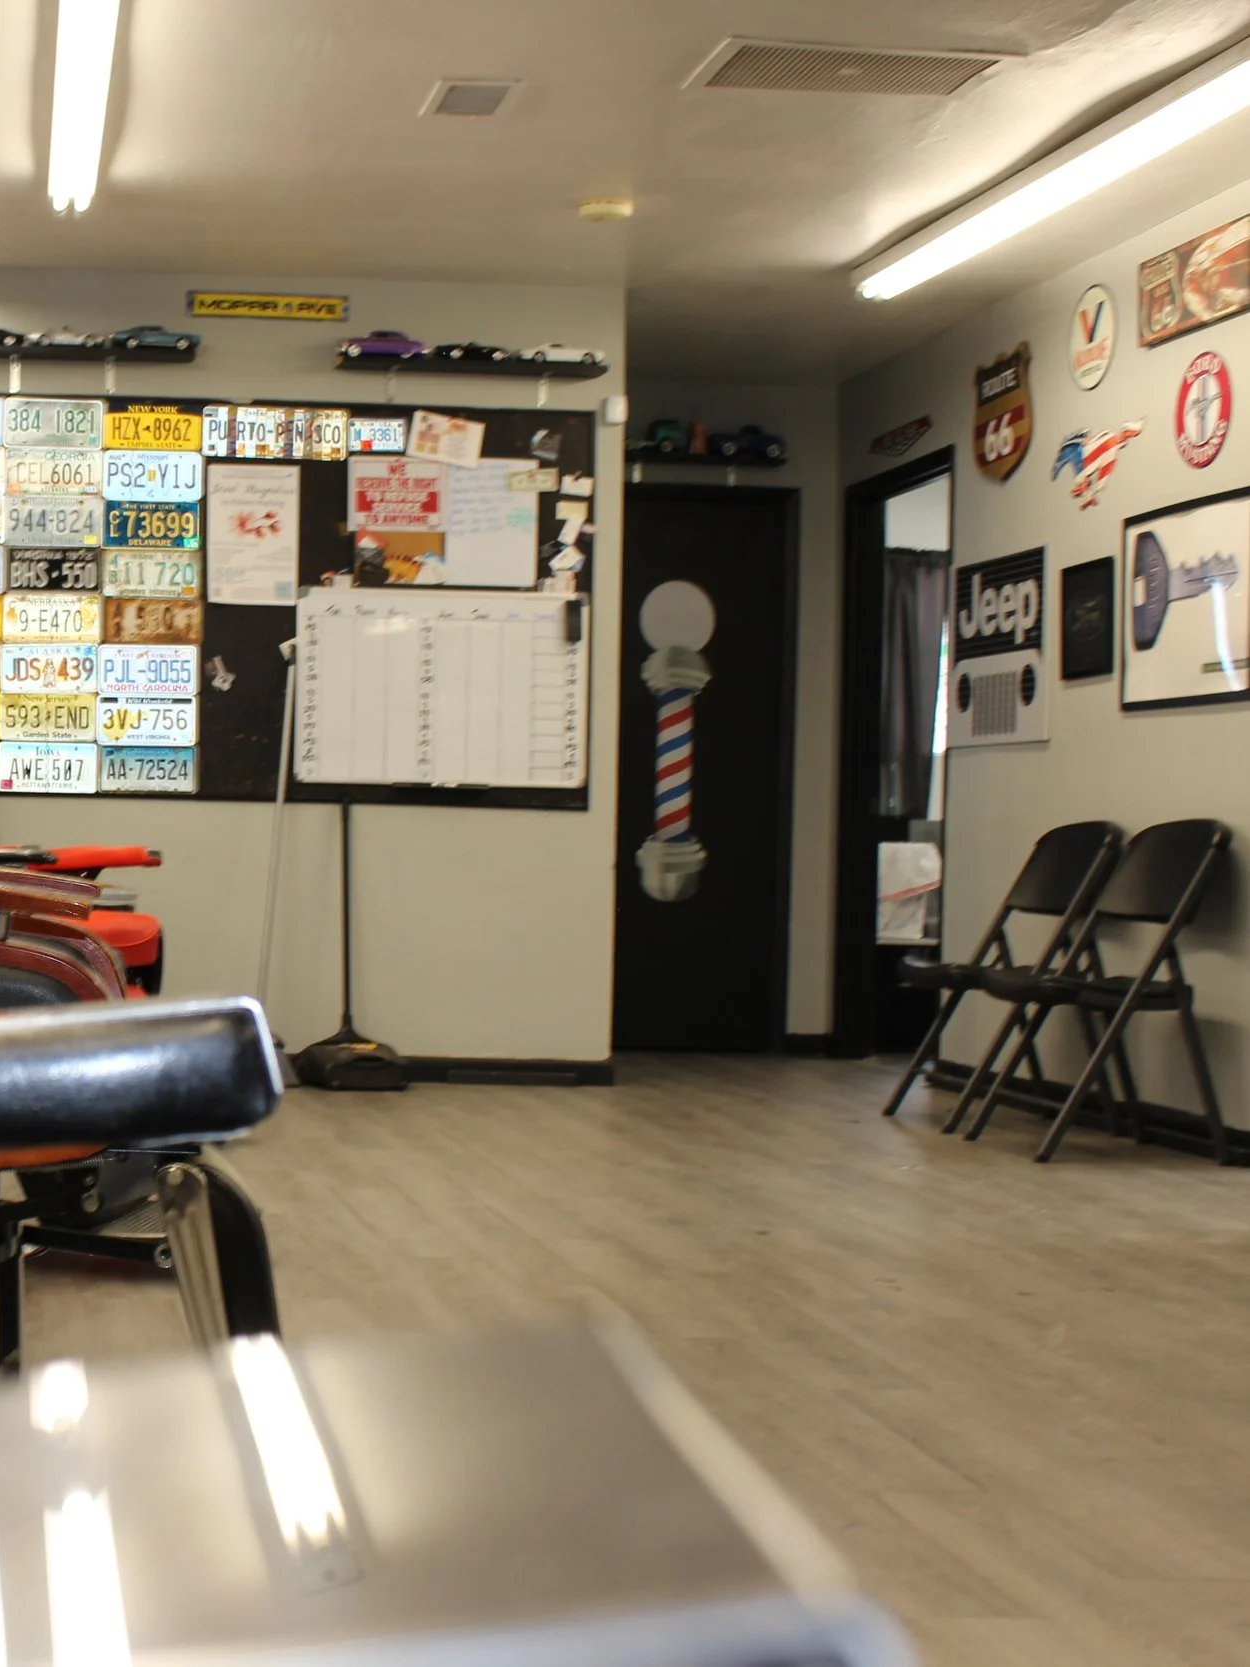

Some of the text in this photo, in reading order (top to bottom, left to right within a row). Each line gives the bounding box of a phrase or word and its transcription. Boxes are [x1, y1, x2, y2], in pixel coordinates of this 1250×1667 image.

[981, 366, 1019, 400] ROUTE
[128, 405, 178, 414] NEW YORK
[8, 409, 96, 434] 384 1821
[153, 418, 191, 441] 8962
[370, 428, 398, 442] 3361
[984, 412, 1017, 463] 66
[137, 453, 170, 461] Missouri
[16, 462, 95, 486] CEL6061
[107, 462, 196, 489] PS2 Y1J
[9, 509, 94, 533] 944-824
[123, 510, 196, 539] 73699
[128, 538, 172, 547] DELAWARE
[27, 597, 76, 606] NEBRASKA
[958, 573, 1041, 645] Jeep
[19, 609, 83, 632] 9-E470
[5, 657, 96, 682] JDS 439
[104, 659, 191, 684] PJL-9055
[20, 693, 75, 704] New Jersey
[142, 684, 189, 693] CAROLINA
[103, 709, 188, 732] 3VJ-756
[22, 731, 49, 739] Garden
[9, 758, 84, 782] AWE 507
[107, 759, 188, 782] AA-72524
